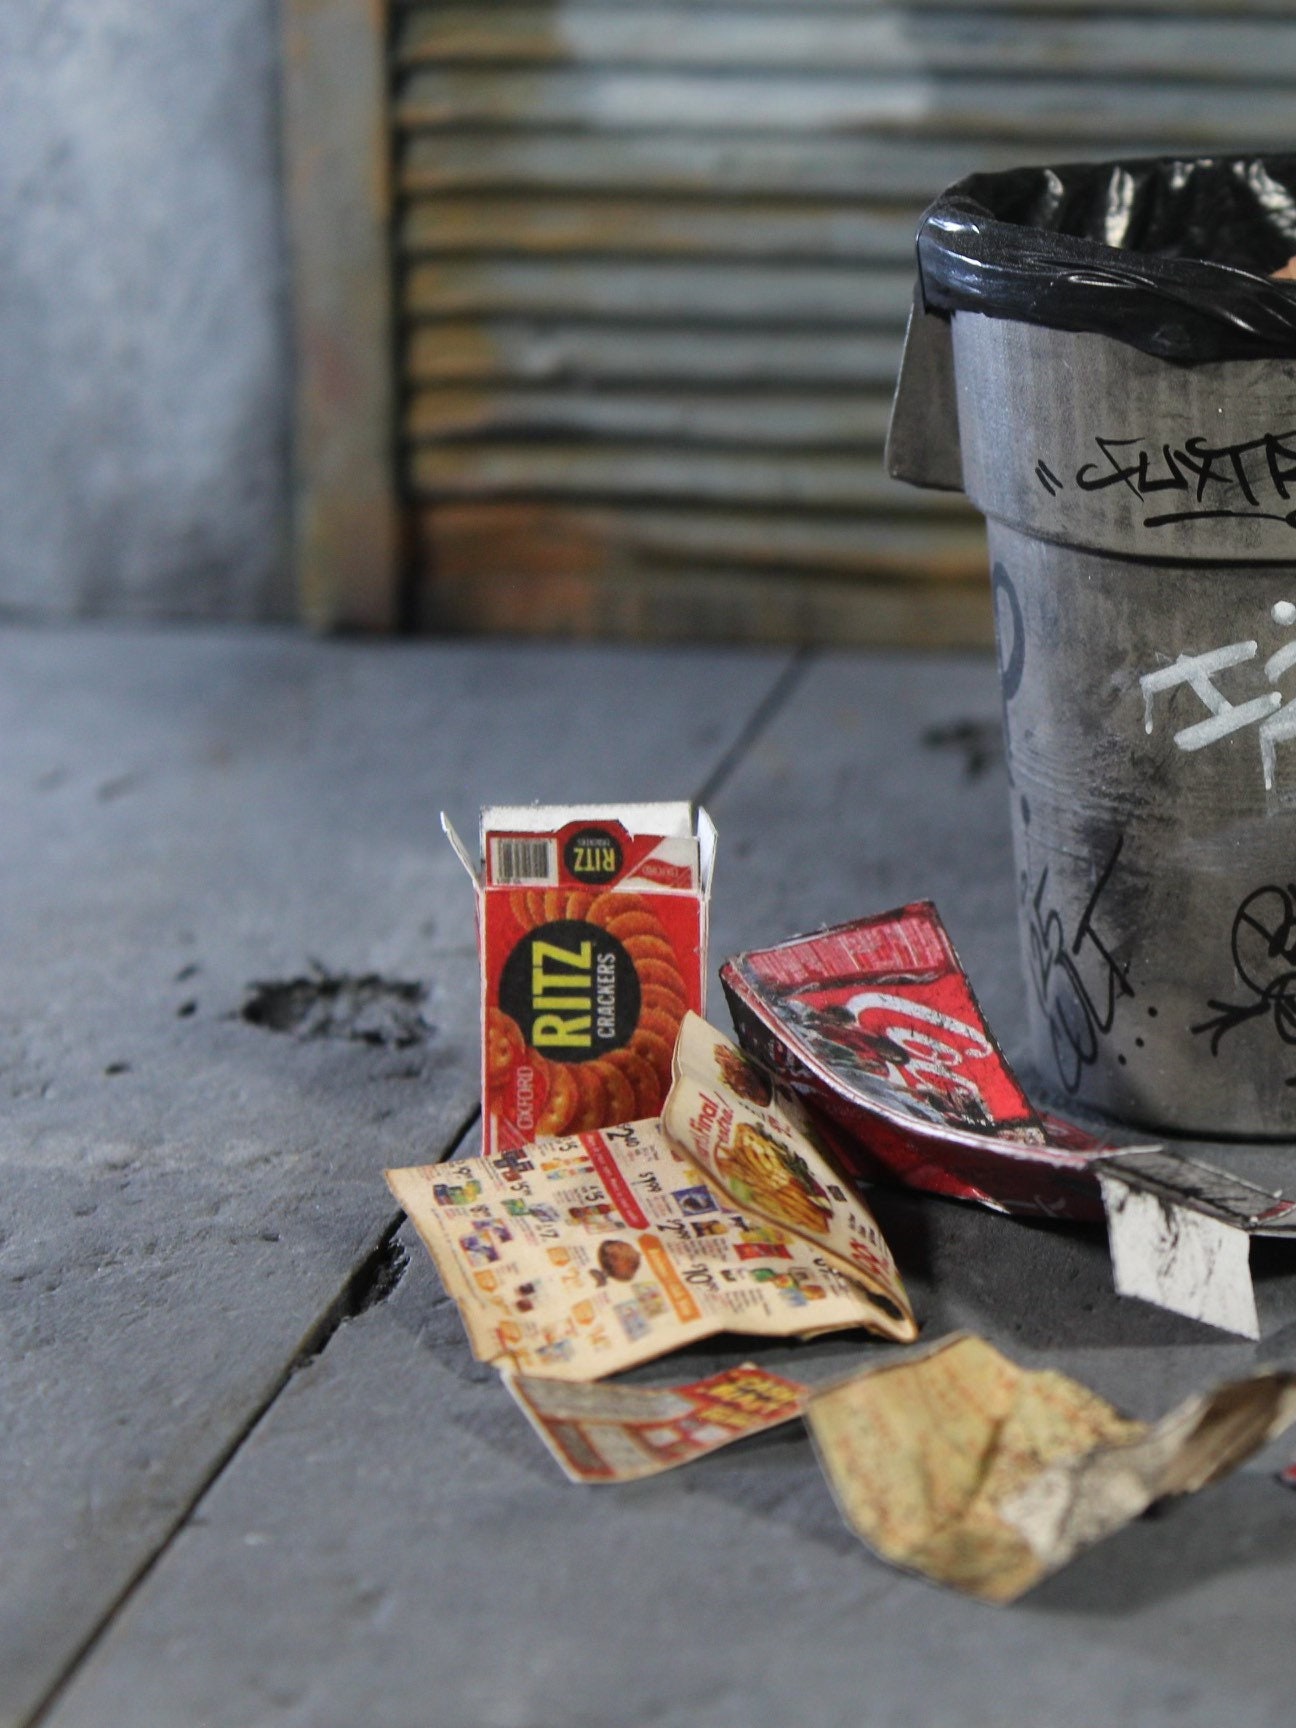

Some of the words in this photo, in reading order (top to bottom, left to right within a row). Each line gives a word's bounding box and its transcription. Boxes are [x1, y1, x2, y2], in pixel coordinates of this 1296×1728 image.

[574, 847, 615, 872] RITZ
[532, 940, 592, 1047] RITZ
[597, 953, 616, 1039] CRACKERS
